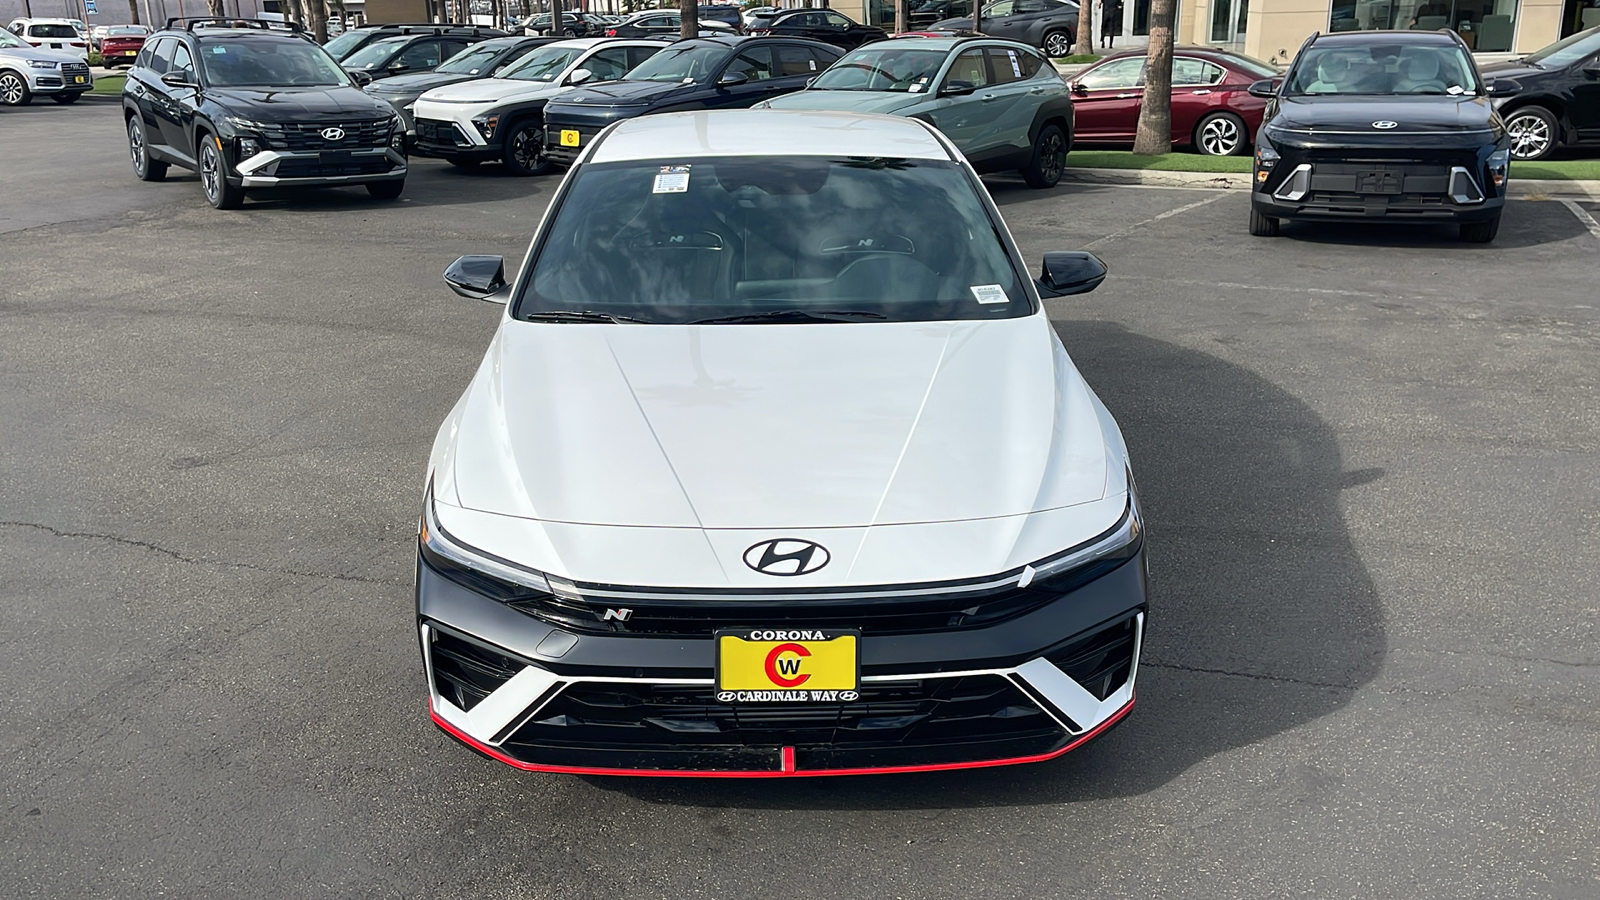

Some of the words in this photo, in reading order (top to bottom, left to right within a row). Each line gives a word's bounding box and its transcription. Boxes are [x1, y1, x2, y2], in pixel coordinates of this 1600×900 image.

[669, 235, 684, 243] N
[858, 238, 873, 247] N
[603, 608, 633, 621] N
[750, 630, 825, 641] CORONA
[764, 642, 812, 688] C
[778, 657, 802, 675] W
[737, 690, 808, 702] CARDINALE
[810, 690, 839, 702] WAY
